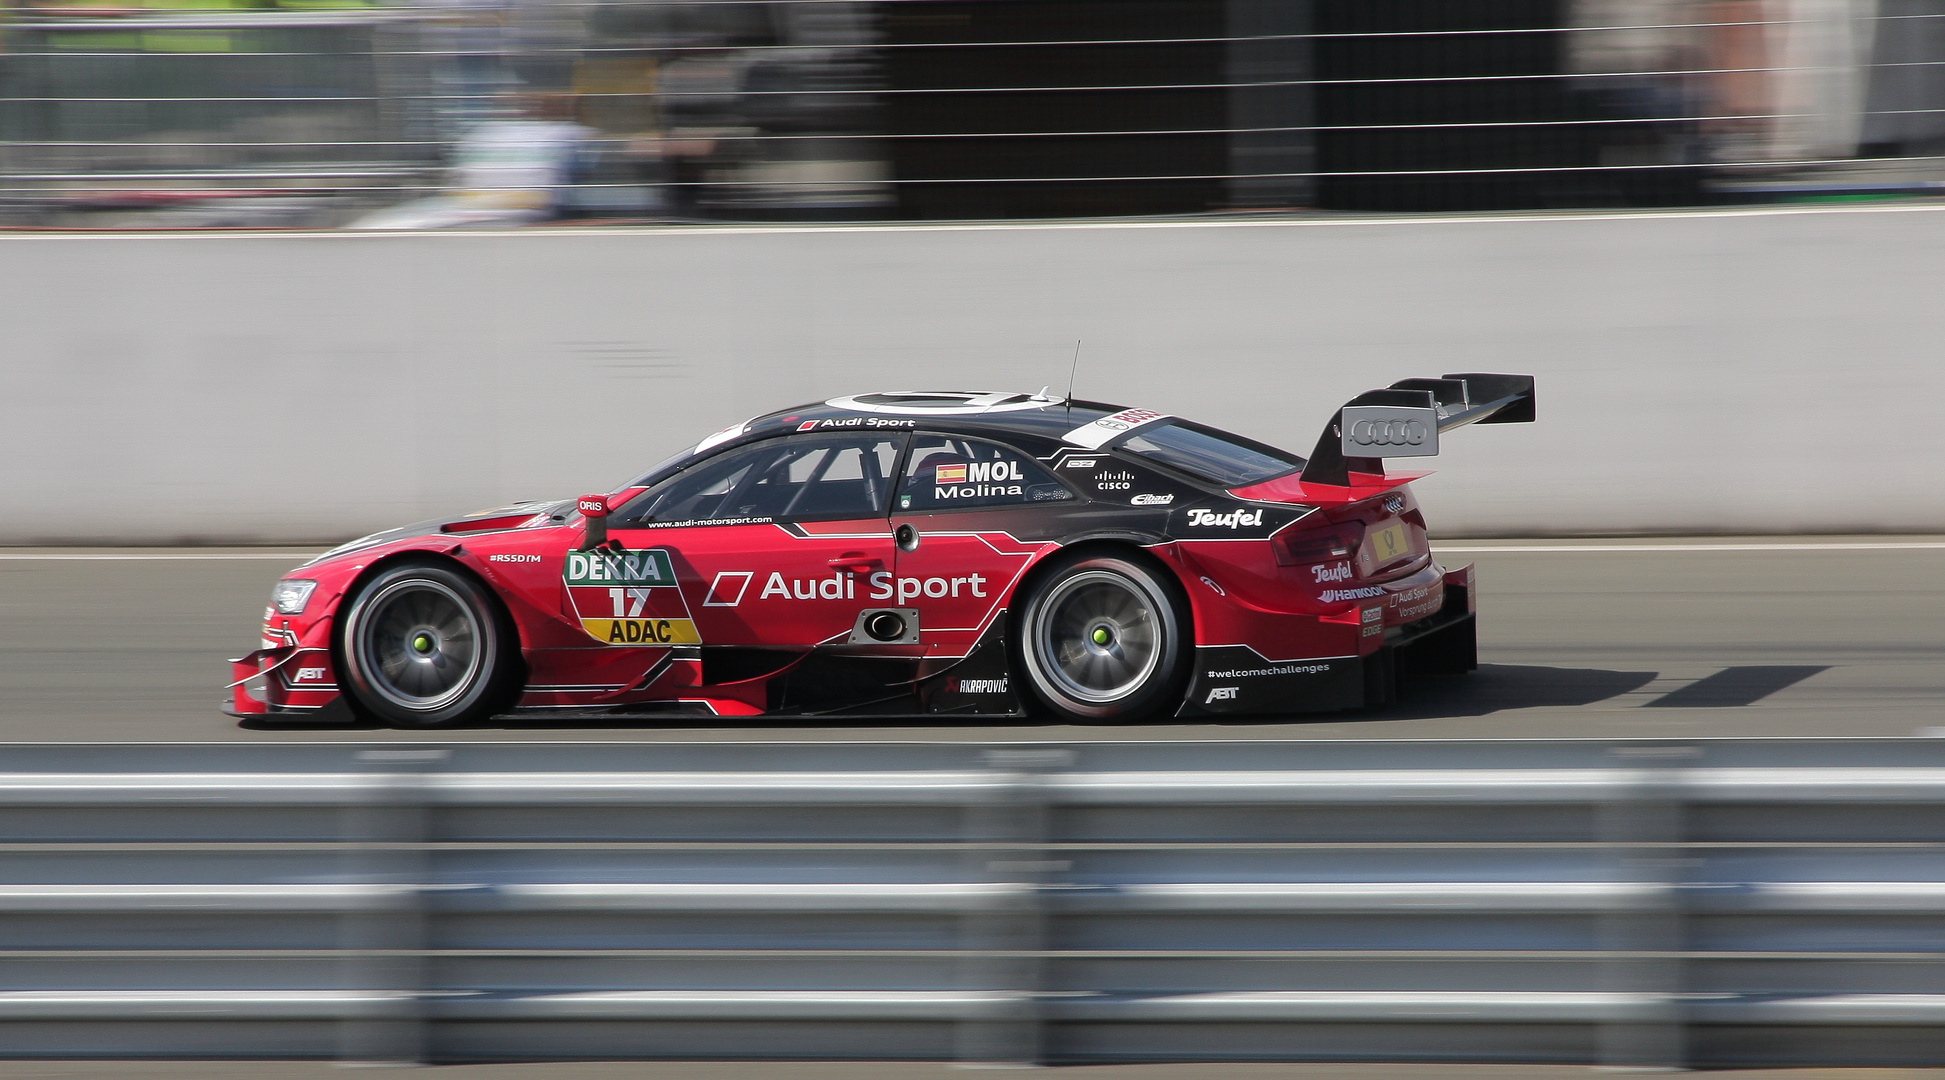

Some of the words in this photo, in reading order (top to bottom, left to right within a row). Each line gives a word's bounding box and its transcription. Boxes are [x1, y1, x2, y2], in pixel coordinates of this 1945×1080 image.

[820, 417, 862, 428] Audi
[866, 417, 915, 428] Sport
[969, 461, 1023, 482] MOL
[935, 485, 1022, 500] Molina
[1131, 494, 1174, 505] Eibach
[579, 501, 602, 511] ORIS
[648, 517, 772, 529] www.audi-motorsport.com
[1187, 508, 1262, 529] Teufel
[569, 555, 661, 580] DEKRA
[1311, 561, 1353, 583] Teufel
[760, 571, 854, 600] Audi
[870, 571, 987, 605] Sport
[1399, 590, 1414, 603] Audi
[1414, 587, 1428, 601] Sport
[608, 588, 651, 617] 17
[608, 620, 671, 642] ADAC
[1362, 624, 1382, 637] EDGE
[293, 668, 326, 682] ABT
[1208, 664, 1330, 678] #welcomechallenges
[1205, 687, 1239, 704] ABT
